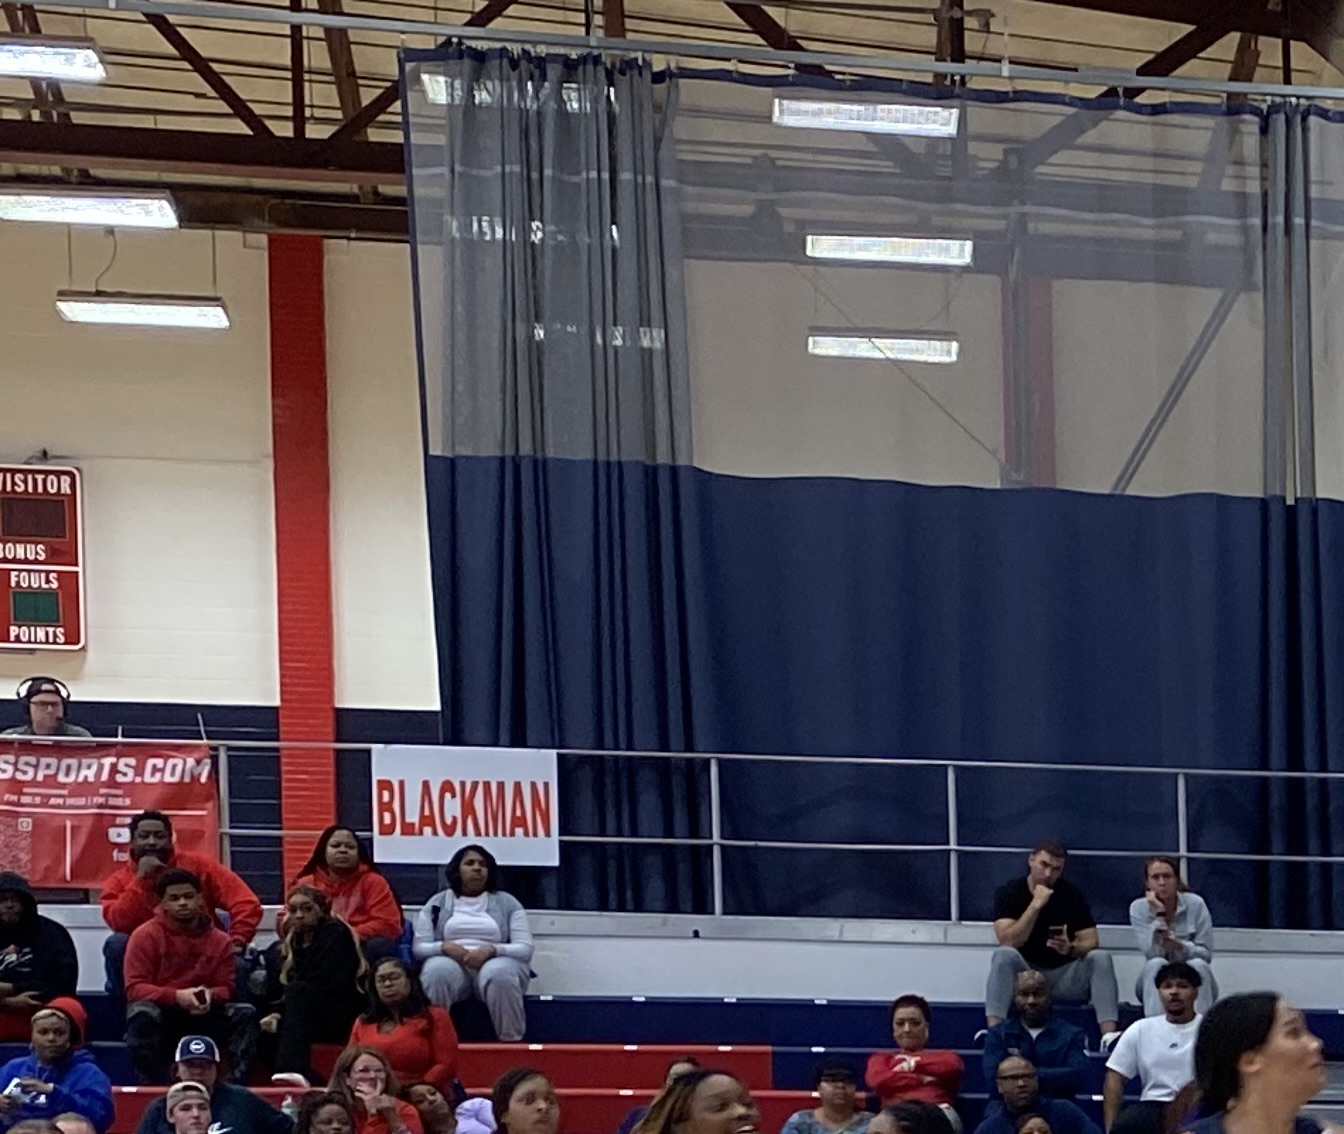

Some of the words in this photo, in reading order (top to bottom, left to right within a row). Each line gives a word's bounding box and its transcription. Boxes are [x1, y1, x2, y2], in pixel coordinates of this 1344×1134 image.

[0, 472, 72, 494] ISITOR
[10, 571, 59, 589] FOULS
[9, 625, 65, 644] POINTS
[0, 754, 212, 784] SSPORTS.COM
[376, 778, 550, 838] BLACKMAN
